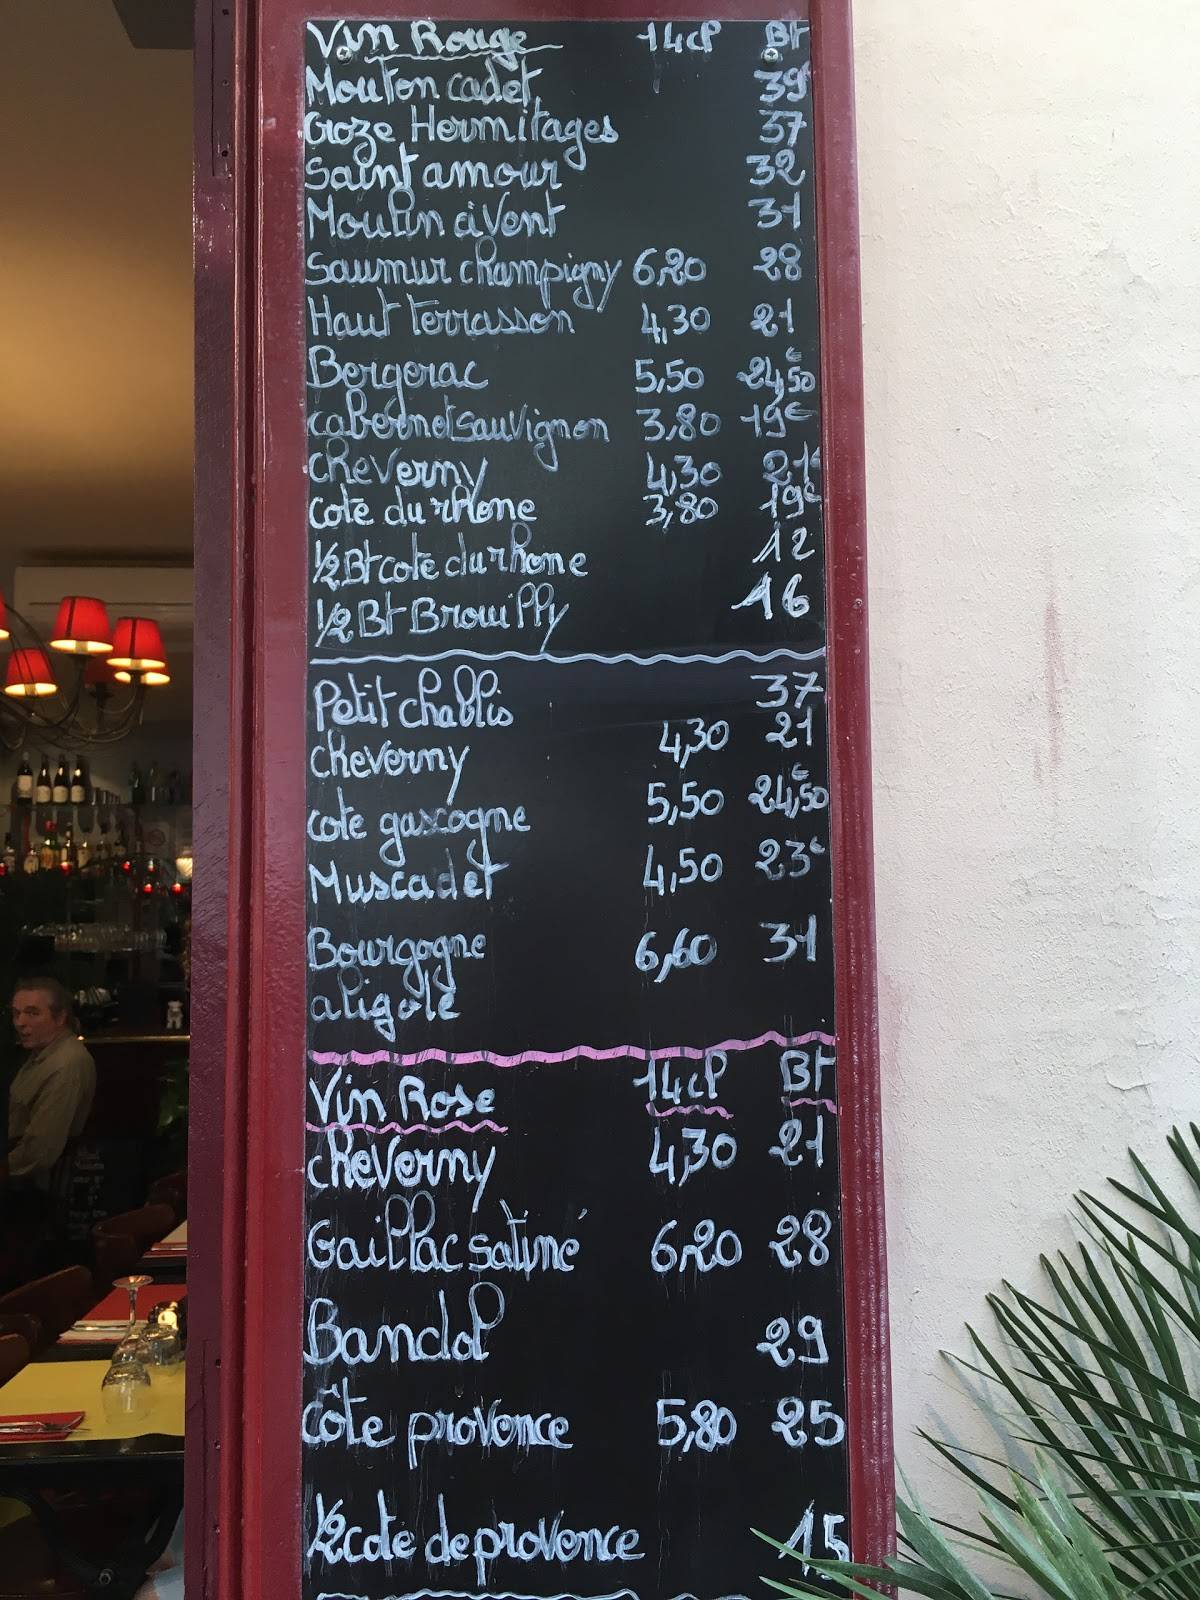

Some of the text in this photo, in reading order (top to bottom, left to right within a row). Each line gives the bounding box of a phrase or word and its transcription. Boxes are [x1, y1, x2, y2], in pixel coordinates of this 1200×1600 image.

[306, 20, 527, 71] Vin Rouge
[305, 57, 543, 106] Mouton cadet
[410, 96, 618, 170] Hermitages
[759, 110, 807, 147] 37
[304, 143, 562, 191] Saint amour
[746, 149, 806, 185] 32
[306, 185, 445, 240] Moulin
[747, 192, 801, 230] 31
[632, 247, 706, 287] 6,20
[753, 242, 801, 281] 28
[307, 287, 402, 336] Haut
[641, 302, 711, 344] 4,30
[750, 298, 794, 337] 21
[307, 344, 488, 420] Bergerac
[635, 359, 704, 393] 5,50
[636, 402, 722, 441] 3,80
[646, 452, 723, 496] 4,30
[384, 485, 426, 526] du
[642, 493, 718, 528] 3,80
[444, 532, 487, 576] du
[731, 574, 810, 619] 16
[314, 672, 398, 732] Petit
[750, 672, 825, 708] 37
[659, 718, 729, 768] 4,30
[765, 711, 812, 748] 21
[646, 782, 725, 826] 5,50
[308, 848, 510, 904] Muscadet
[643, 844, 723, 895] 4,50
[307, 926, 486, 998] Bourgogne
[634, 928, 717, 983] 6,60
[760, 914, 817, 963] 31
[309, 1066, 387, 1125] Vin
[648, 1127, 738, 1186] 4,30
[768, 1113, 824, 1168] 21
[651, 1218, 742, 1273] 6,20
[768, 1209, 833, 1270] 28
[303, 1281, 505, 1366] Bandol
[756, 1314, 829, 1368] 29
[656, 1398, 737, 1453] 5,80
[771, 1396, 845, 1448] 25
